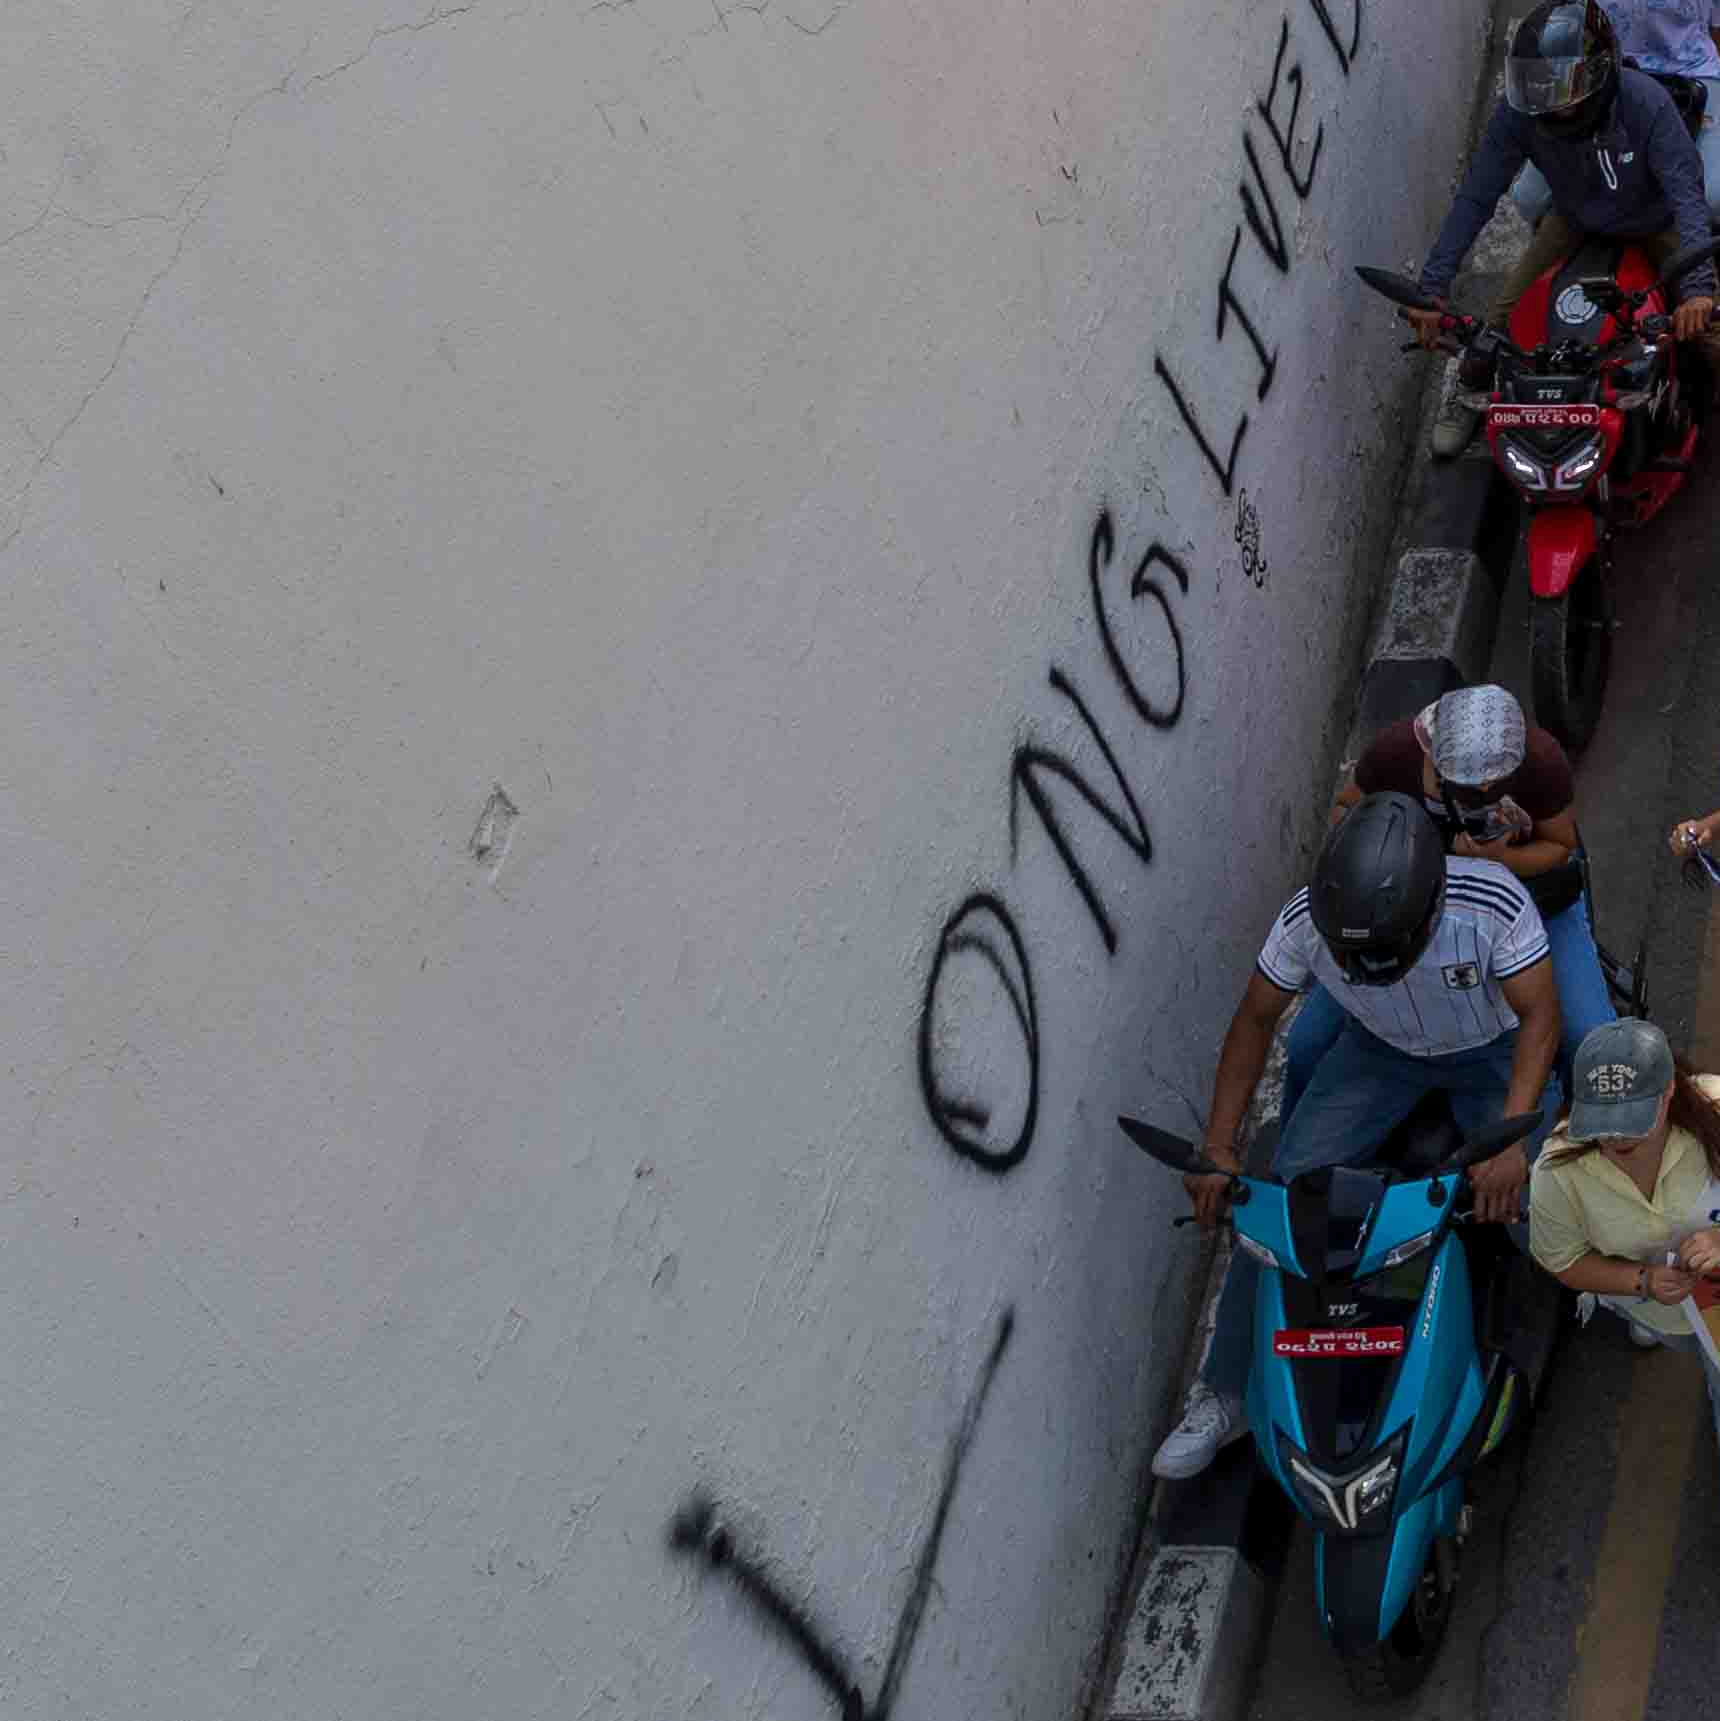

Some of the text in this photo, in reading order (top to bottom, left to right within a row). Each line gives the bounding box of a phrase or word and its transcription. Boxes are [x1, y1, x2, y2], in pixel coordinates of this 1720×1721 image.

[1153, 17, 1325, 496] LIVE
[1537, 389, 1562, 399] TVS
[1327, 1303, 1360, 1316] TVS
